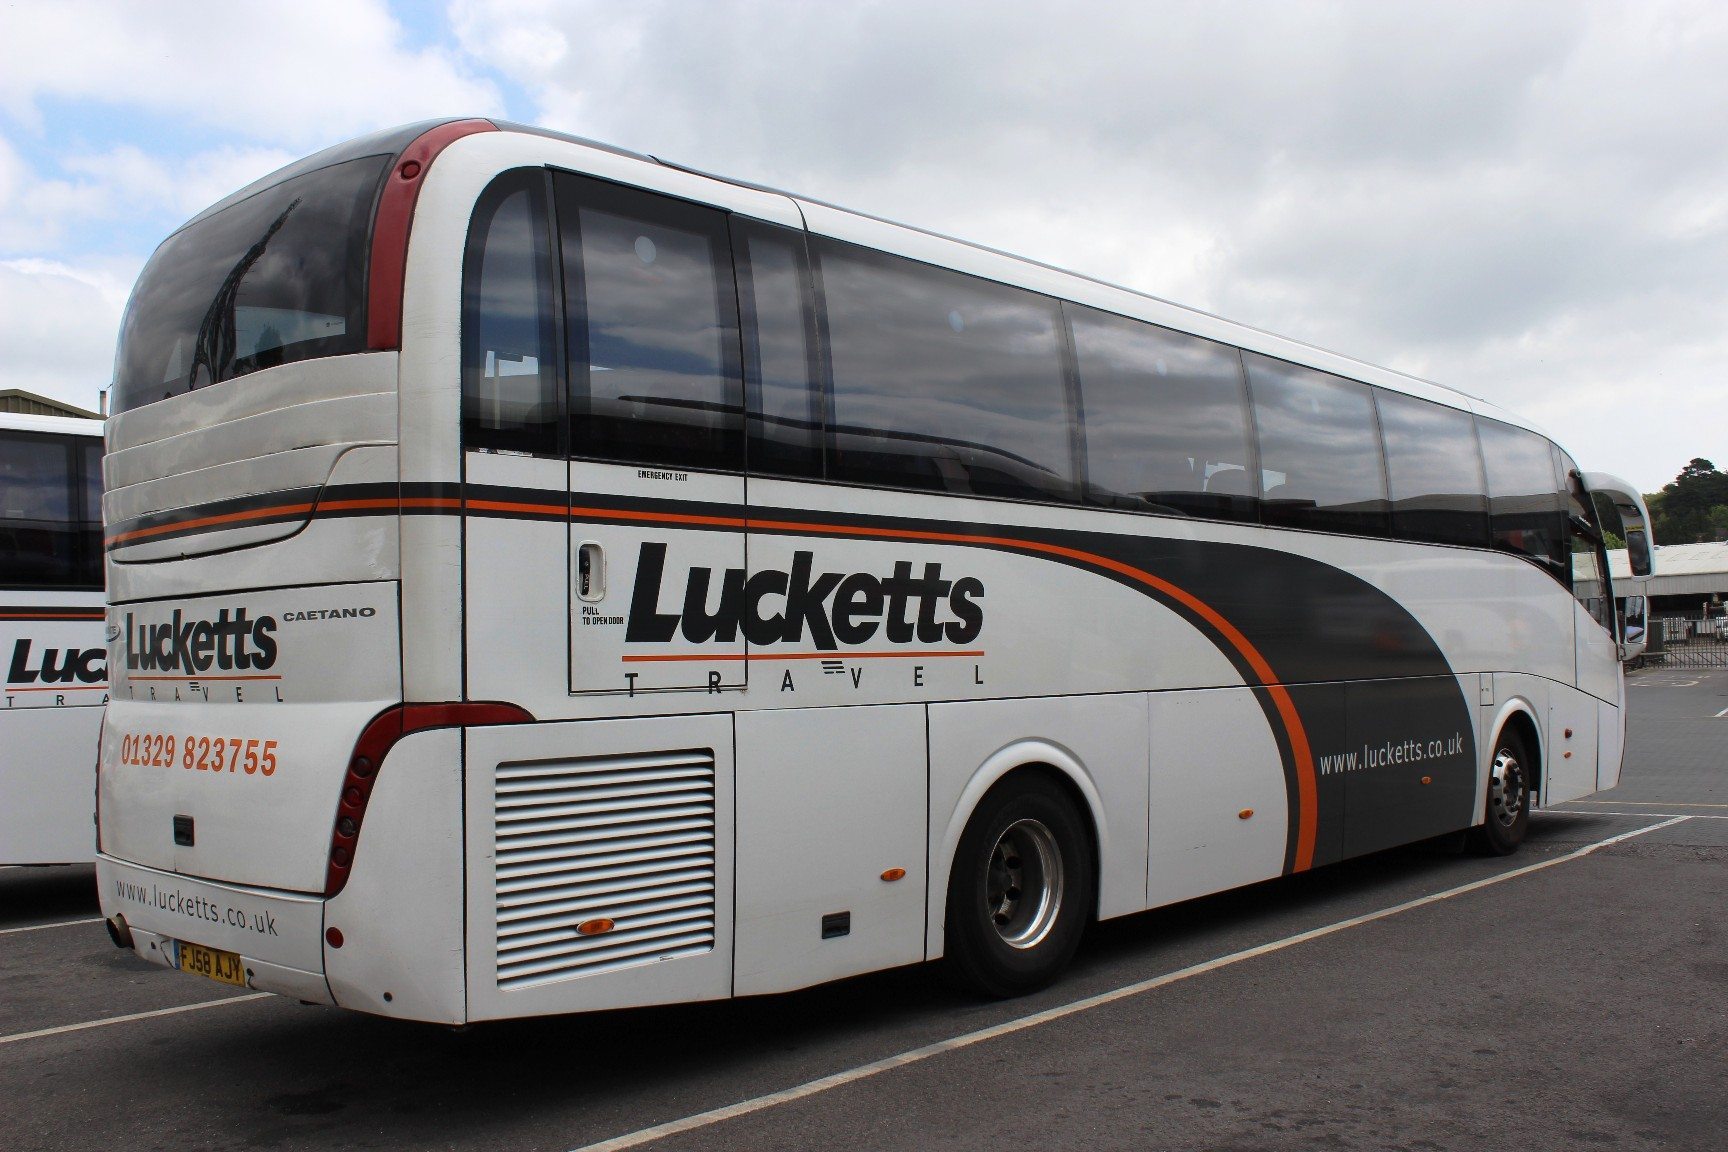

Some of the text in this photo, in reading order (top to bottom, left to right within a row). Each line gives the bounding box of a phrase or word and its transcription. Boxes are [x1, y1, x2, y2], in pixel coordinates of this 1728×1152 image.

[638, 470, 688, 482] EMERGENCY EXIT
[582, 606, 600, 616] PULL
[625, 541, 984, 650] Lucketts
[283, 607, 376, 622] CAETANO
[582, 616, 624, 625] TO OPEN DOOR
[126, 607, 277, 675] Lucketts
[7, 638, 108, 683] Luc
[129, 686, 283, 702] TRAVEL
[625, 664, 984, 697] TRAVEL
[121, 734, 278, 777] 01329 823755
[1320, 732, 1463, 776] www.lucketts.co.uk
[116, 879, 278, 937] www.lucketts.co.uk
[180, 944, 241, 981] FJ58 AJY
